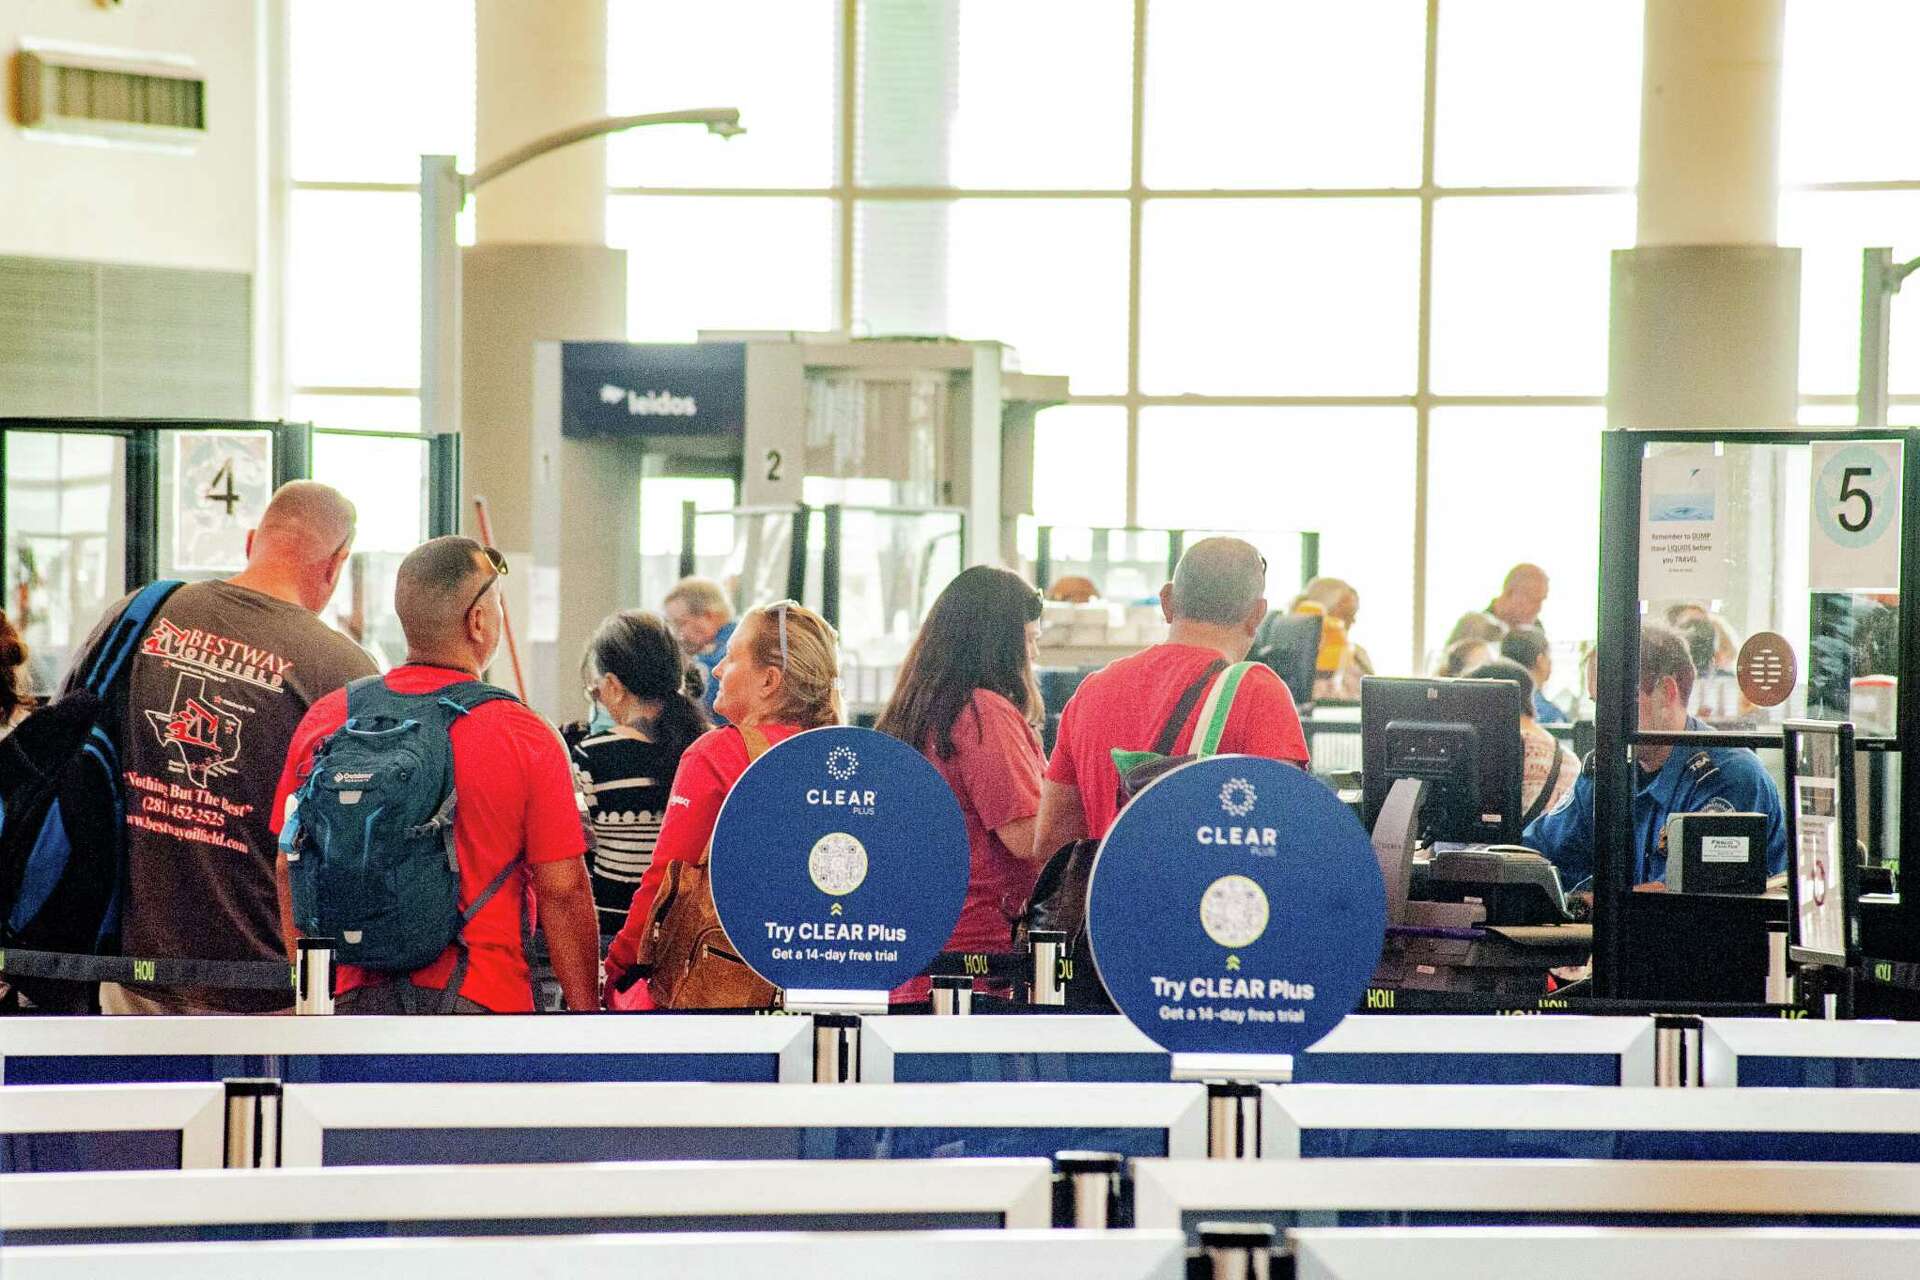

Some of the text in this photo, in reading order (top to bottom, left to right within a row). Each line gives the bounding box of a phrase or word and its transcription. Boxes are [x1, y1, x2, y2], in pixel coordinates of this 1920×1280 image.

[766, 450, 782, 481] 2
[205, 456, 240, 515] 4
[1838, 467, 1873, 532] 5
[188, 629, 294, 675] BESTWAY
[185, 647, 284, 687] OILFIELD
[170, 783, 193, 801] But
[196, 788, 220, 806] The
[806, 788, 876, 806] CLEAR
[142, 796, 225, 826] (281) 452-2525
[852, 806, 875, 816] PLUS
[1197, 825, 1277, 846] CLEAR
[765, 922, 906, 943] Try CLEAR Plus
[772, 948, 898, 963] Get a 14-day free trial
[964, 954, 988, 975] HOU
[134, 960, 155, 981] HOU
[1059, 958, 1073, 979] OU
[1151, 976, 1315, 1002] Try CLEAR Plus
[1159, 1005, 1305, 1025] Get a 14-day free trial
